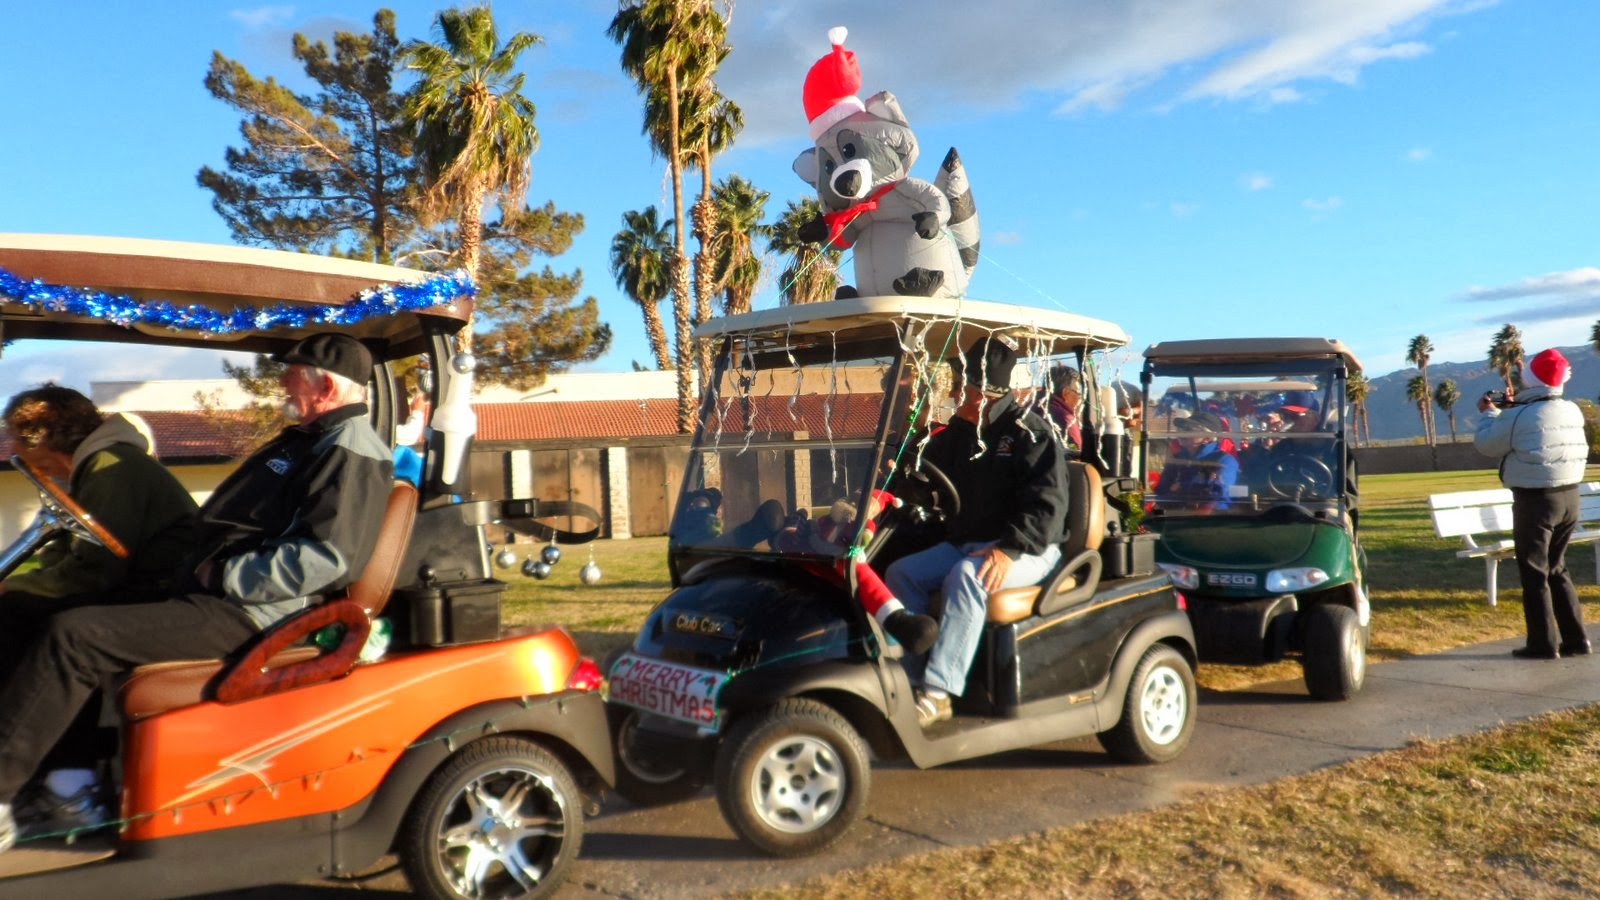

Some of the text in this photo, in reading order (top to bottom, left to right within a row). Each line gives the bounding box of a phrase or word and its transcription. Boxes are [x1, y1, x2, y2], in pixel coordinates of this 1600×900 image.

[676, 614, 698, 631] Club
[625, 660, 702, 693] MERRY
[610, 676, 715, 723] CHRISTMAS
